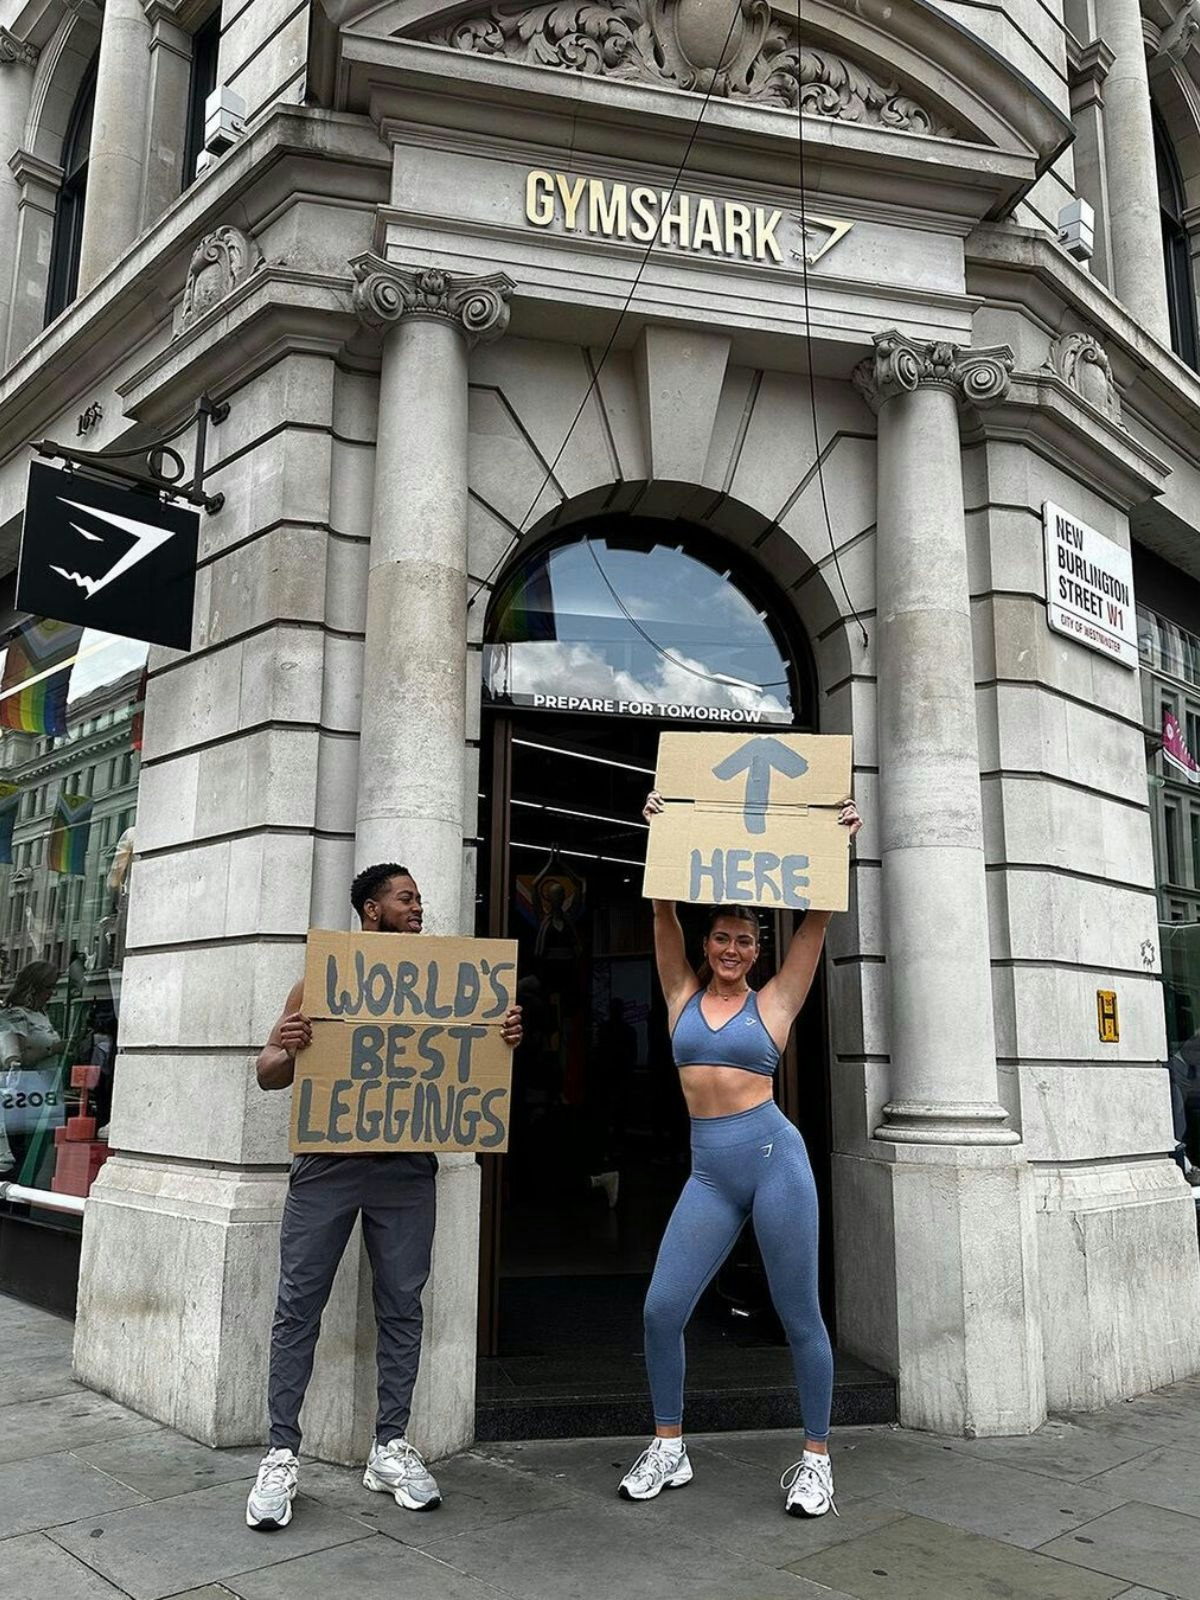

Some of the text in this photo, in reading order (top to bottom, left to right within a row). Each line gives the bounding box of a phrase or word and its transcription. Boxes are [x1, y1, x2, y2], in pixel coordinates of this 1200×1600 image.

[525, 170, 784, 263] GYMSHARK
[1056, 515, 1083, 551] NEW
[1057, 544, 1130, 607] BURLINGTON
[1059, 575, 1124, 631] STREET W1
[534, 694, 763, 723] PREPARE FOR TOMORROW
[689, 848, 811, 909] HERE
[326, 950, 515, 1019] WORLD'S
[350, 1024, 488, 1083] BEST
[297, 1078, 508, 1147] LEGGINGS
